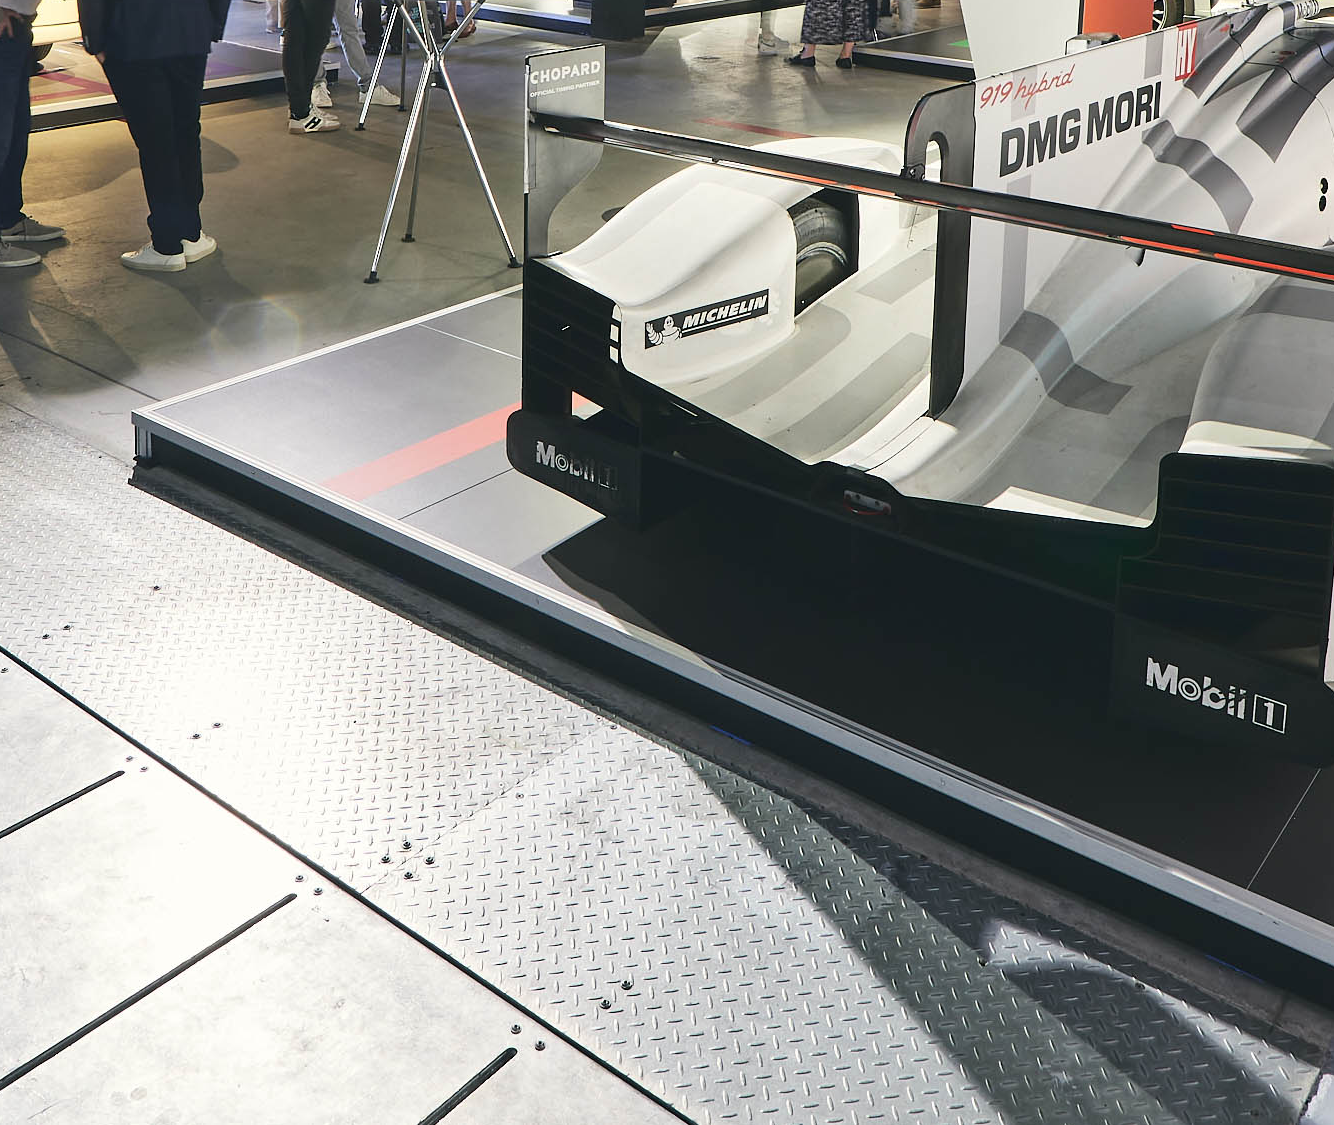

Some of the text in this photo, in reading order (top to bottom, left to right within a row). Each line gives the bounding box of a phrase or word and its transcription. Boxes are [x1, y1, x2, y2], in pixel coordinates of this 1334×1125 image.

[530, 60, 601, 85] CHOPARD
[1175, 26, 1198, 78] HY
[530, 88, 555, 98] OFFICIAL
[980, 63, 1075, 111] 919 hybrid
[999, 81, 1162, 178] DMG MORI
[682, 295, 768, 329] MICHELIN
[1146, 656, 1248, 720] Mobil
